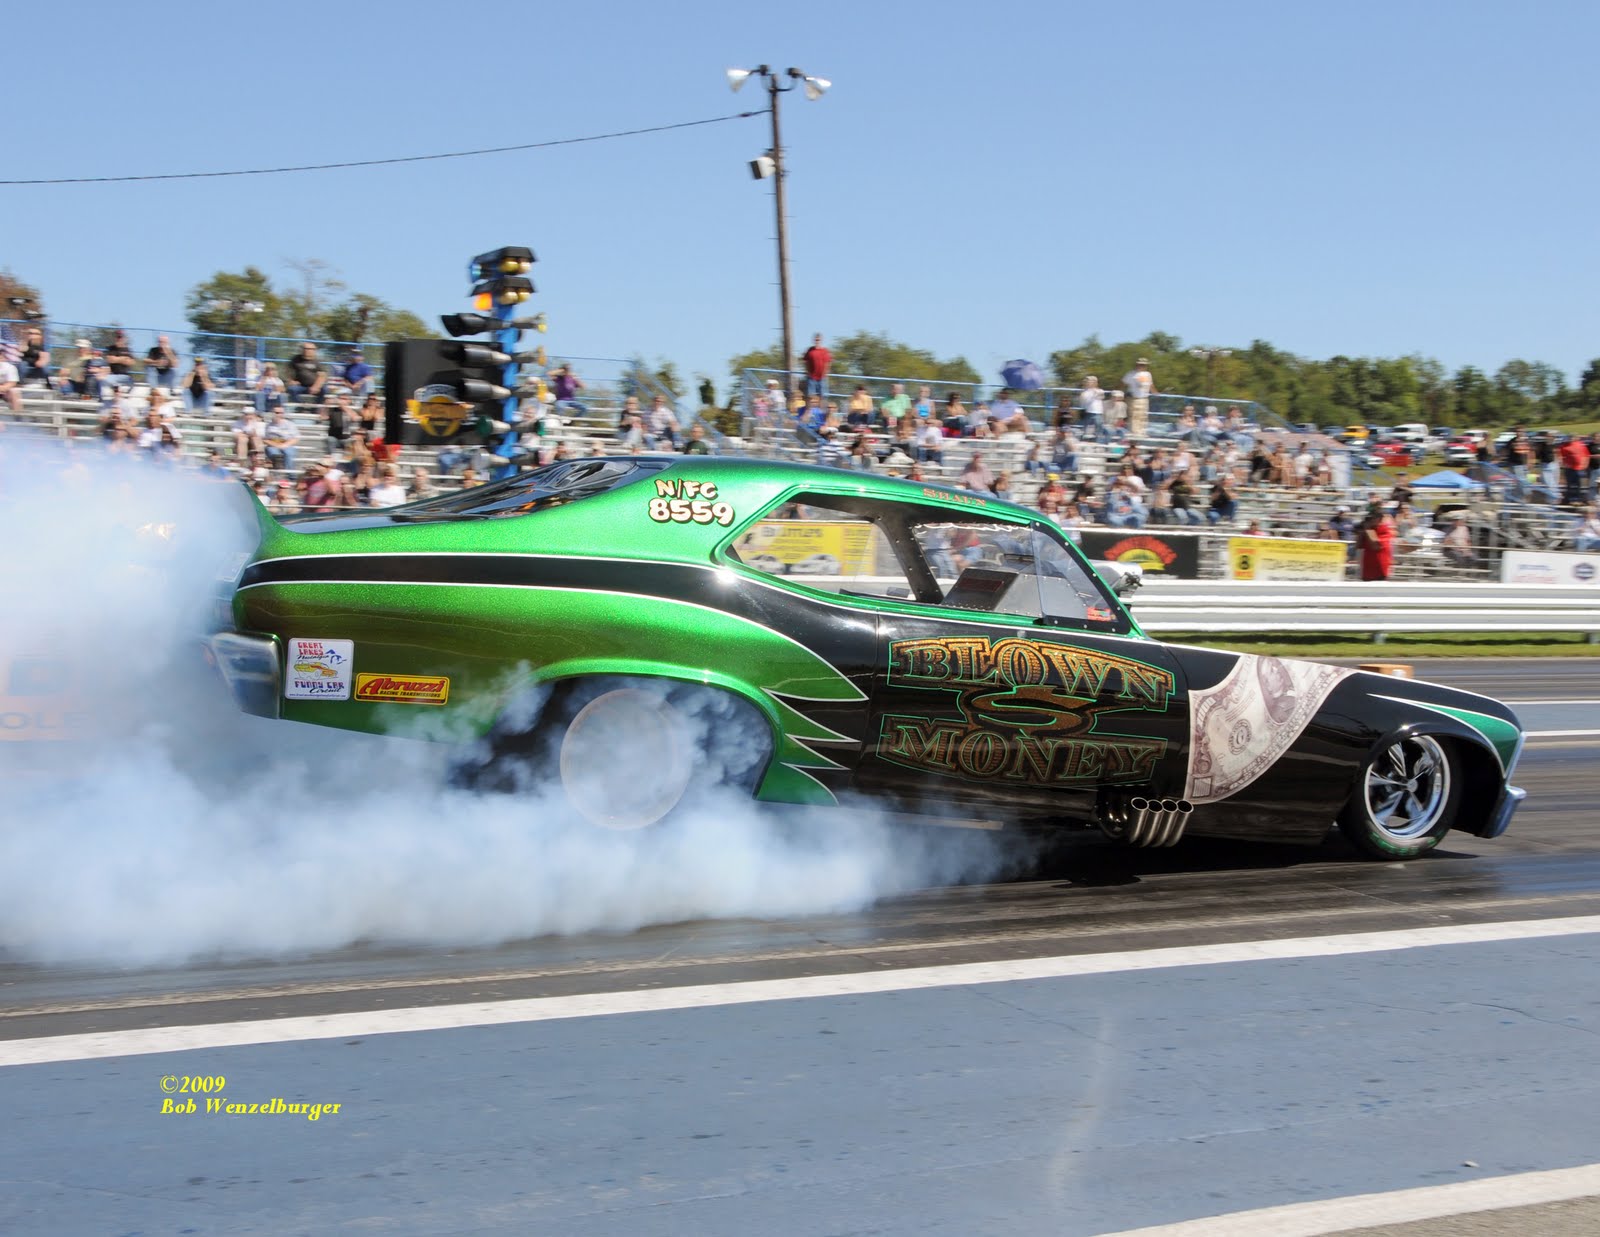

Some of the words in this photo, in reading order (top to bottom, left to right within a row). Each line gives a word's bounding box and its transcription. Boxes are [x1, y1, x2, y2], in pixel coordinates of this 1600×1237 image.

[648, 498, 735, 527] 8559
[294, 681, 324, 689] FUNNY
[326, 681, 345, 690] CAR
[890, 638, 1174, 704] BLOWN
[359, 677, 446, 695] Abruzzi
[884, 720, 1165, 783] MONEY
